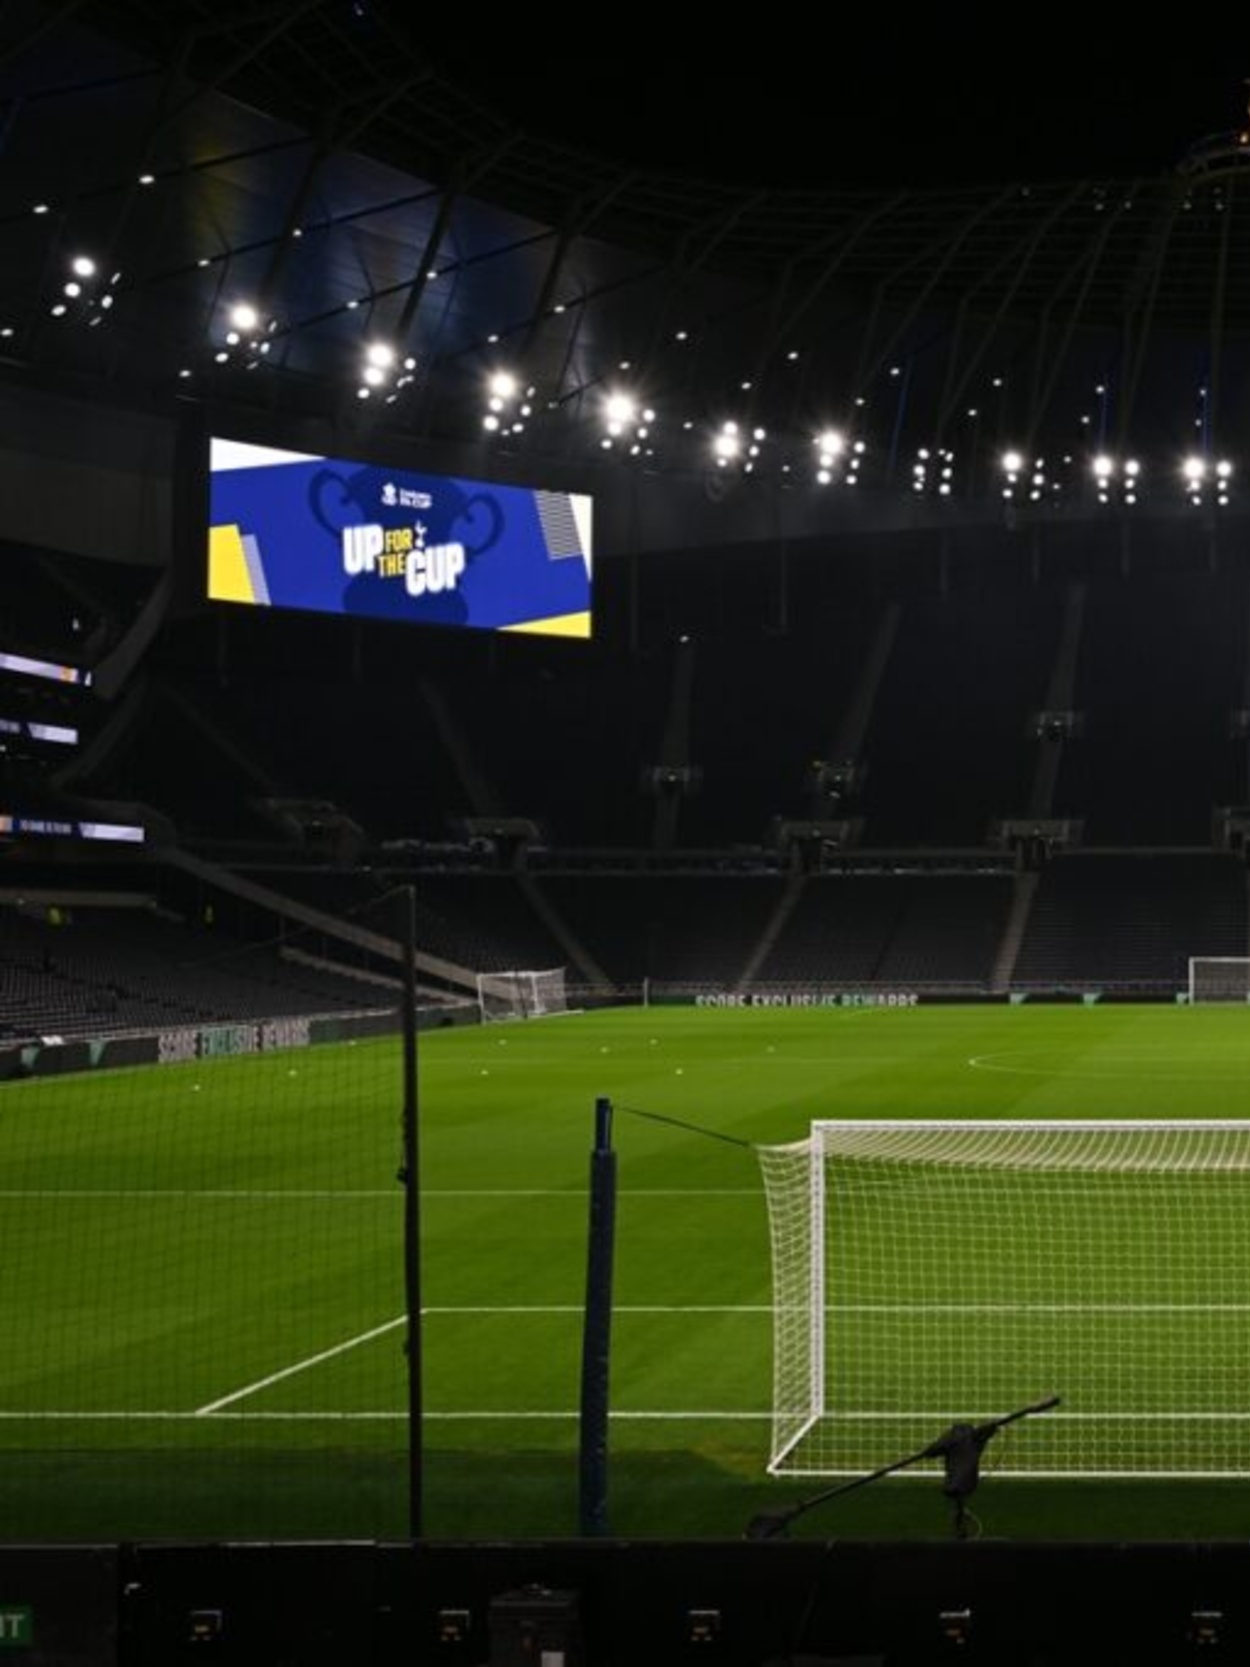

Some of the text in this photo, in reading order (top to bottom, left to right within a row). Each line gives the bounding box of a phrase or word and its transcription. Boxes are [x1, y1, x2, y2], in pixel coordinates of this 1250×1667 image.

[343, 524, 465, 596] UP FOR THE CUP
